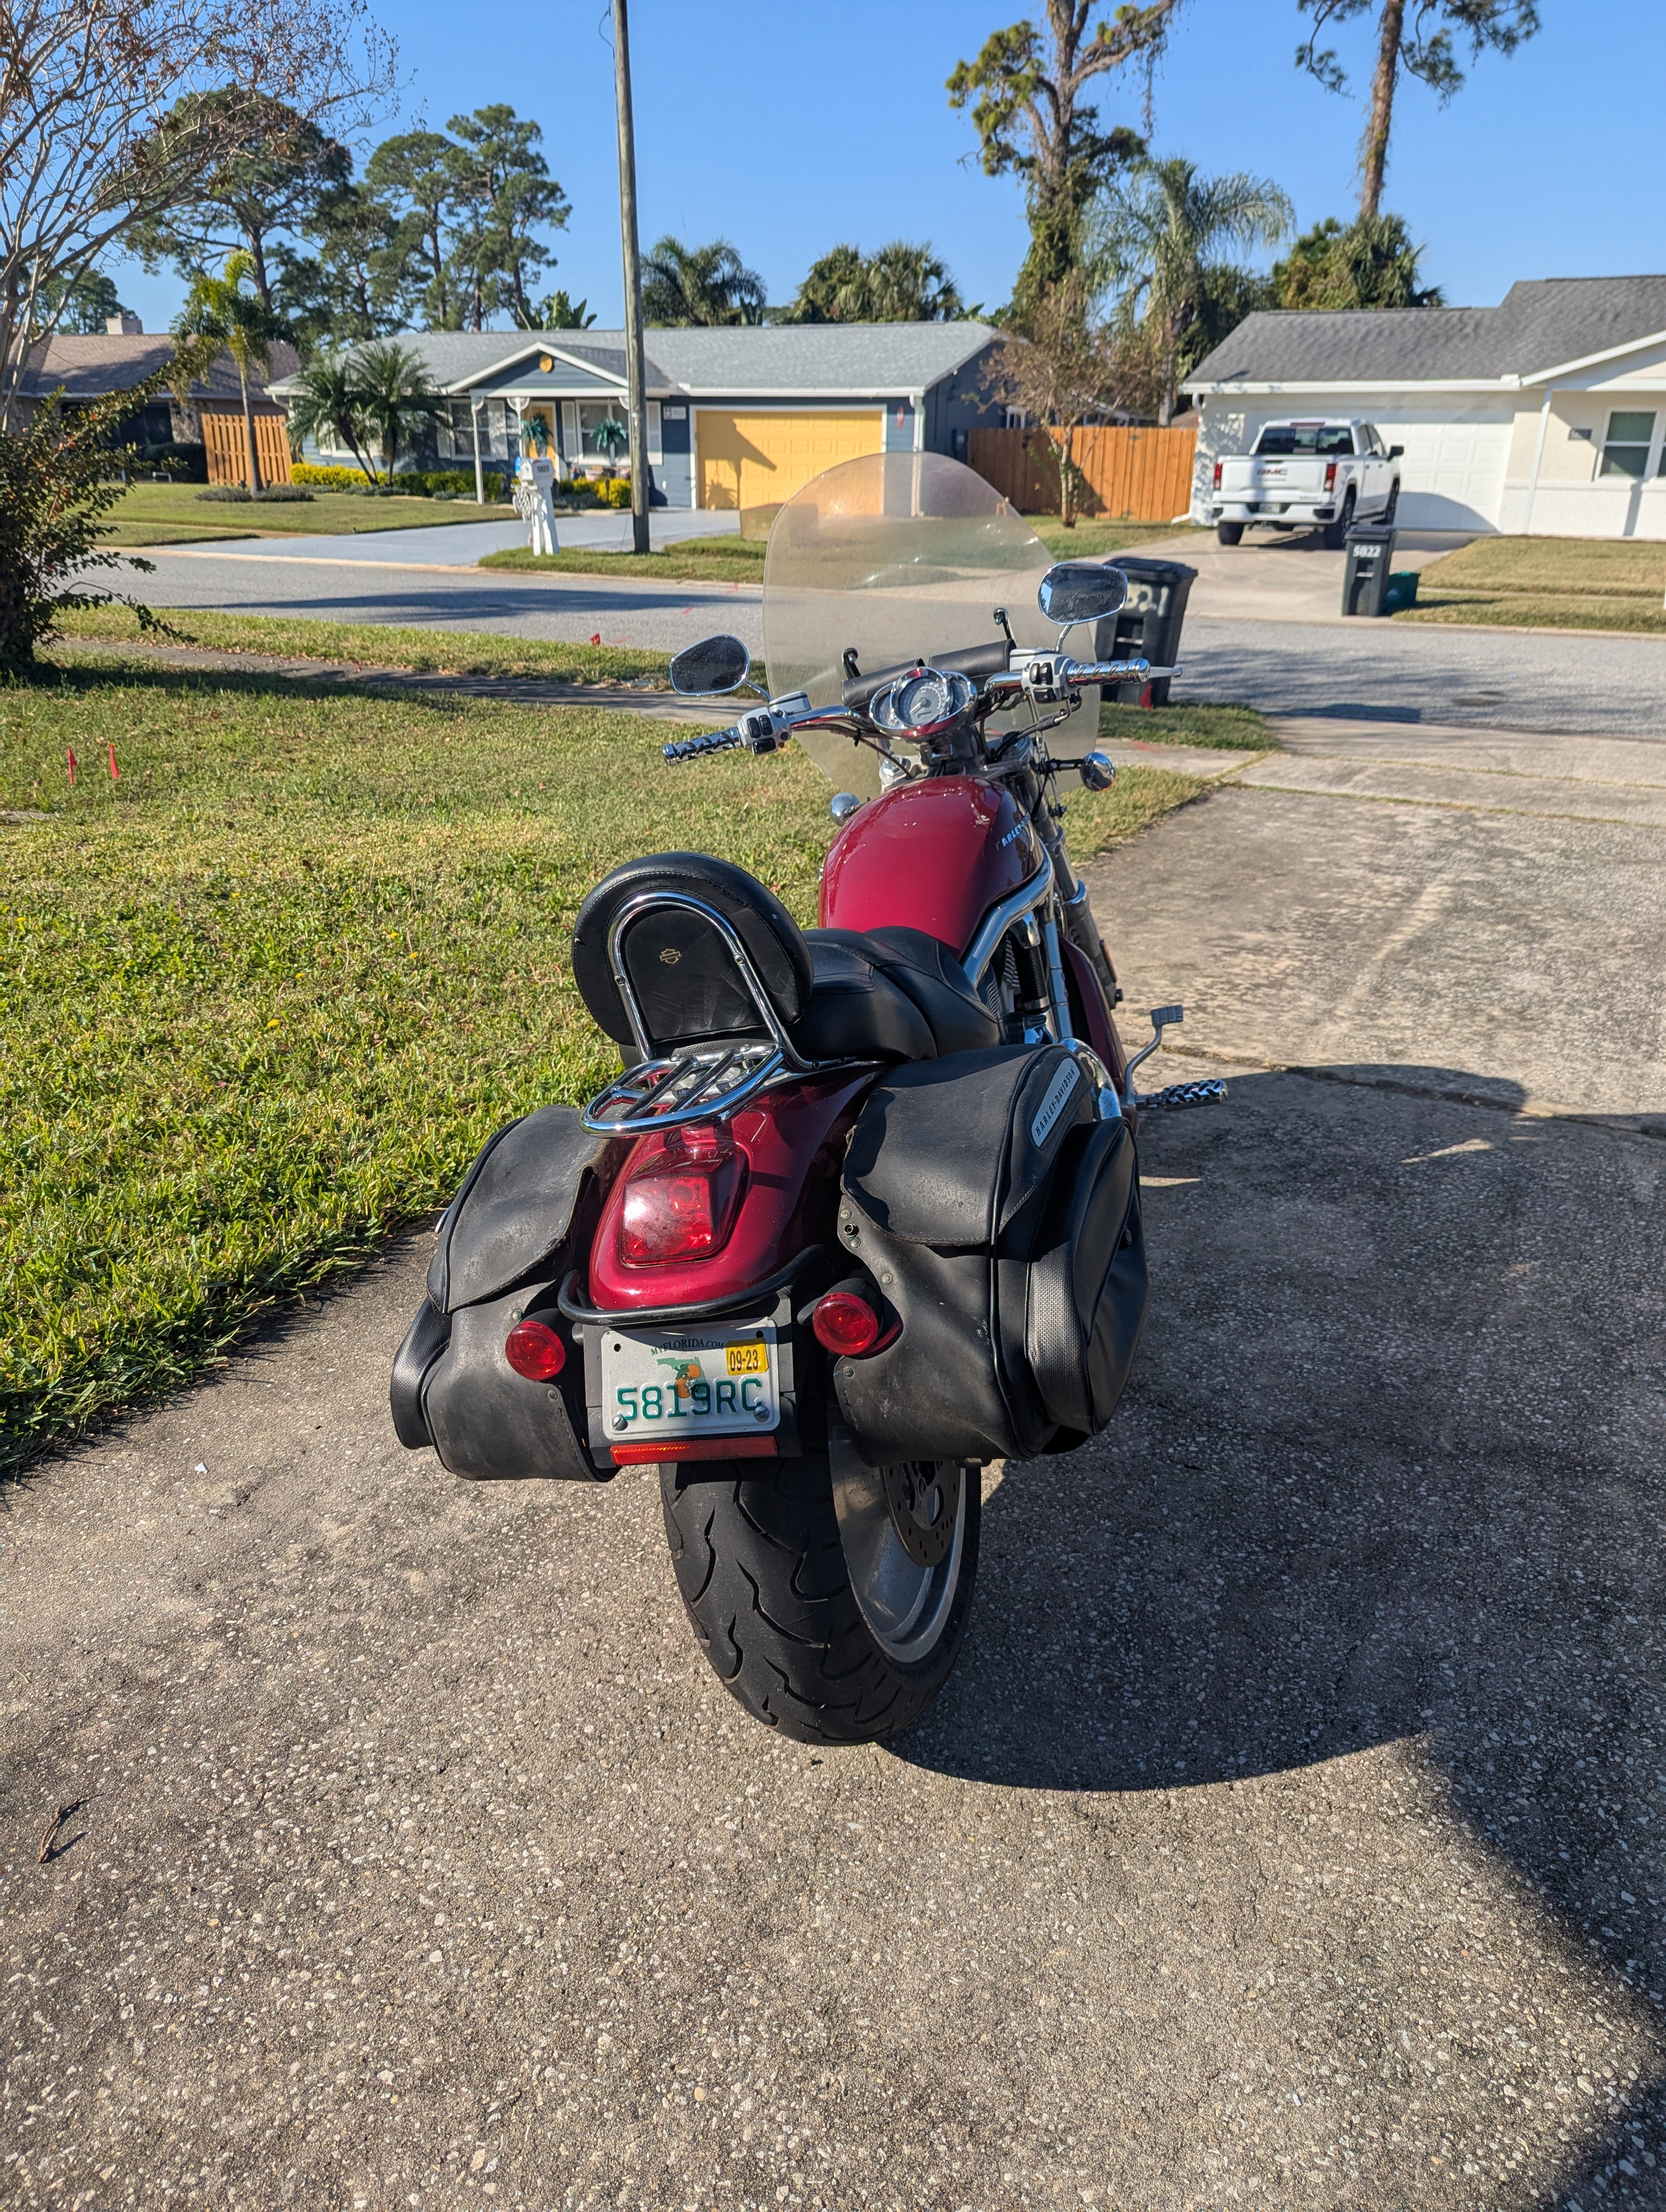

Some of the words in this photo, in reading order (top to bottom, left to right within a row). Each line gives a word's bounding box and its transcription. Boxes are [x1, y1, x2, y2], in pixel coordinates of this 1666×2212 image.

[1035, 1067, 1075, 1137] HARLEY-DAVIDSON
[650, 1338, 725, 1355] MYFLORIDA.COM
[729, 1349, 759, 1372] 09-23
[617, 1378, 762, 1420] 5819RC
